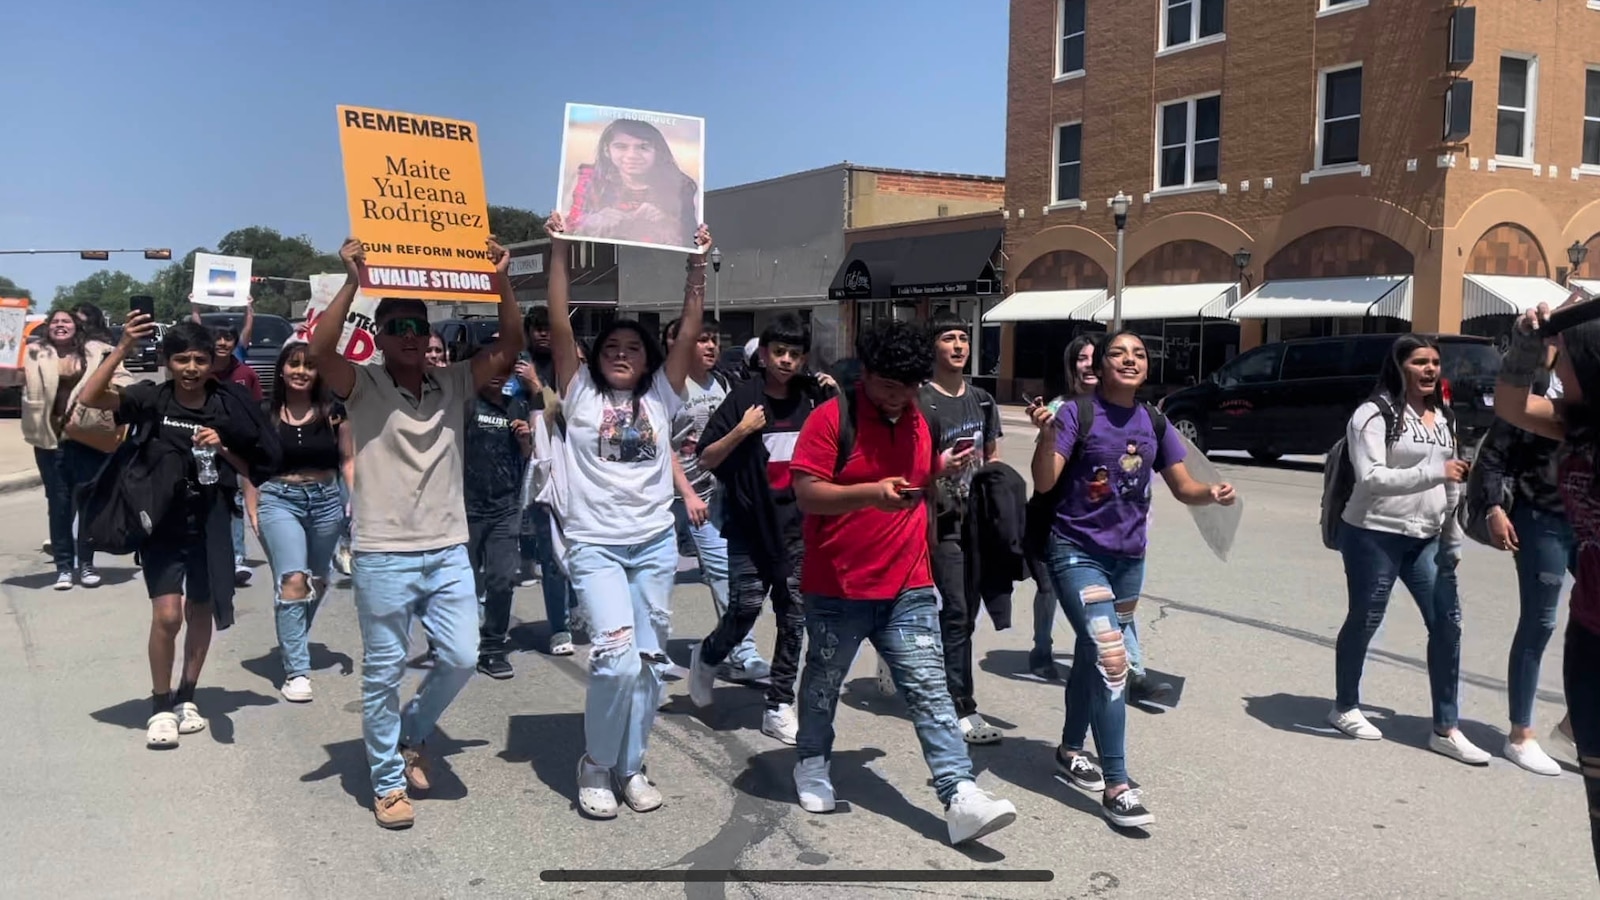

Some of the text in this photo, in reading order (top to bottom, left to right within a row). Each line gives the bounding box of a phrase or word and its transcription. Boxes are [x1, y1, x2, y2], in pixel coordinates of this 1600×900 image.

[345, 110, 474, 143] REMEMBER
[385, 155, 451, 181] Maite
[373, 177, 467, 205] Yuleana
[362, 199, 483, 232] Rodriguez
[361, 243, 489, 260] GUN REFORM NOW
[368, 267, 491, 291] UVALDE STRONG
[345, 311, 381, 336] OTEC
[160, 415, 202, 436] hamp
